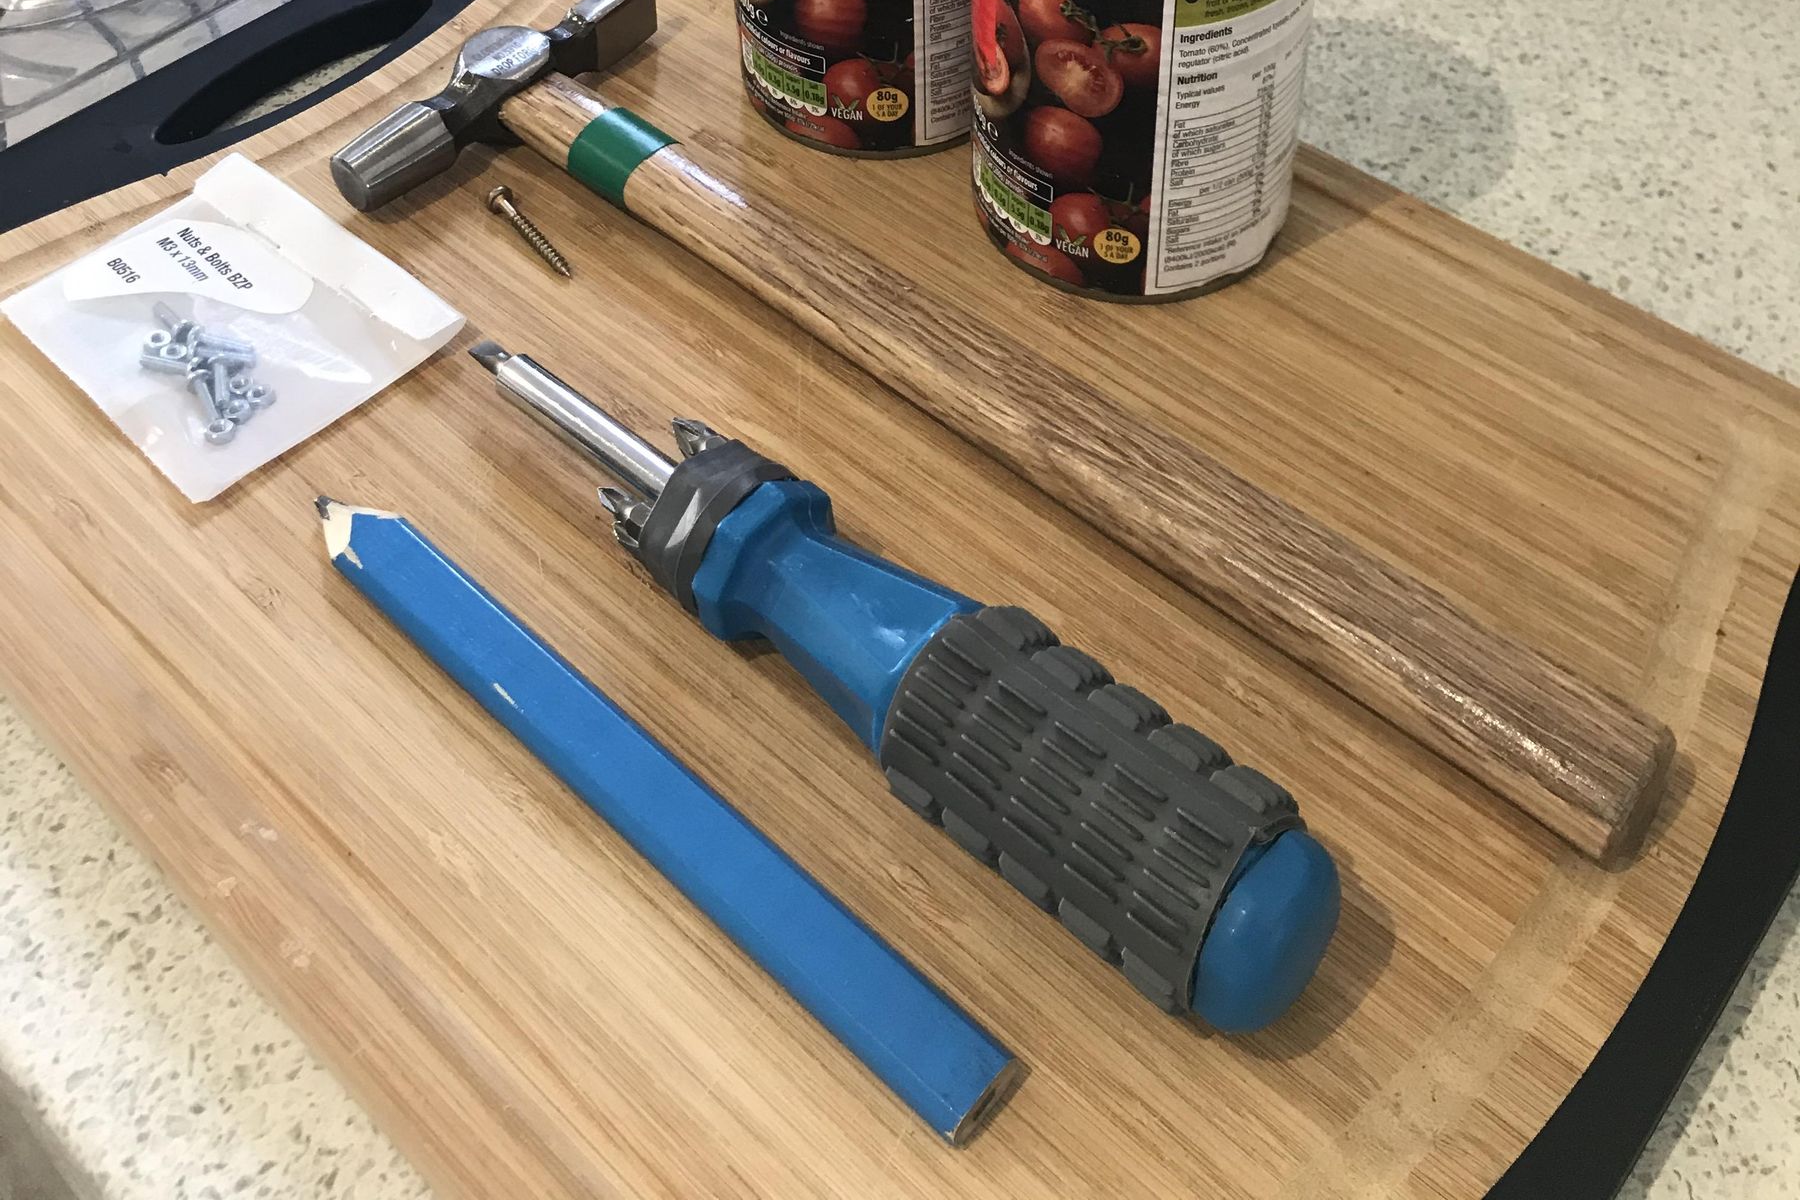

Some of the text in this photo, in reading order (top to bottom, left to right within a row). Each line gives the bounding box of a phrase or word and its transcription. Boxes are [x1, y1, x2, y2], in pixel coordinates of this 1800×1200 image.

[1180, 26, 1233, 44] Ingredients
[786, 48, 811, 66] flavours
[1179, 47, 1207, 58] Tomato
[491, 58, 514, 76] DROP
[1178, 57, 1211, 69] regulator
[1177, 72, 1218, 85] Nutrition
[876, 91, 898, 104] 80g
[1176, 84, 1226, 100] Typical values
[1175, 101, 1201, 110] Energy
[831, 106, 863, 121] VEGAN
[1174, 120, 1186, 129] Fat
[1172, 131, 1181, 139] of
[1182, 127, 1204, 138] which
[1173, 135, 1219, 149] Carbohydrate
[1172, 142, 1226, 158] of which sugars
[1171, 159, 1189, 167] Fibre
[1171, 168, 1196, 177] Protein
[1013, 169, 1039, 191] flavours
[1170, 178, 1184, 186] Salt
[1168, 200, 1192, 209] Energy
[1168, 209, 1179, 217] Fat
[1167, 215, 1200, 226] Saturates
[1166, 227, 1191, 236] Sugars
[1105, 231, 1129, 246] 80g
[1166, 235, 1179, 244] Salt
[1056, 238, 1089, 258] VEGAN
[1115, 245, 1133, 254] YOUR
[156, 236, 178, 253] M3
[177, 254, 209, 282] 13mm
[177, 226, 253, 291] Nuts & Bolts BZP
[106, 257, 141, 284] B0516
[1163, 262, 1193, 272] Contains
